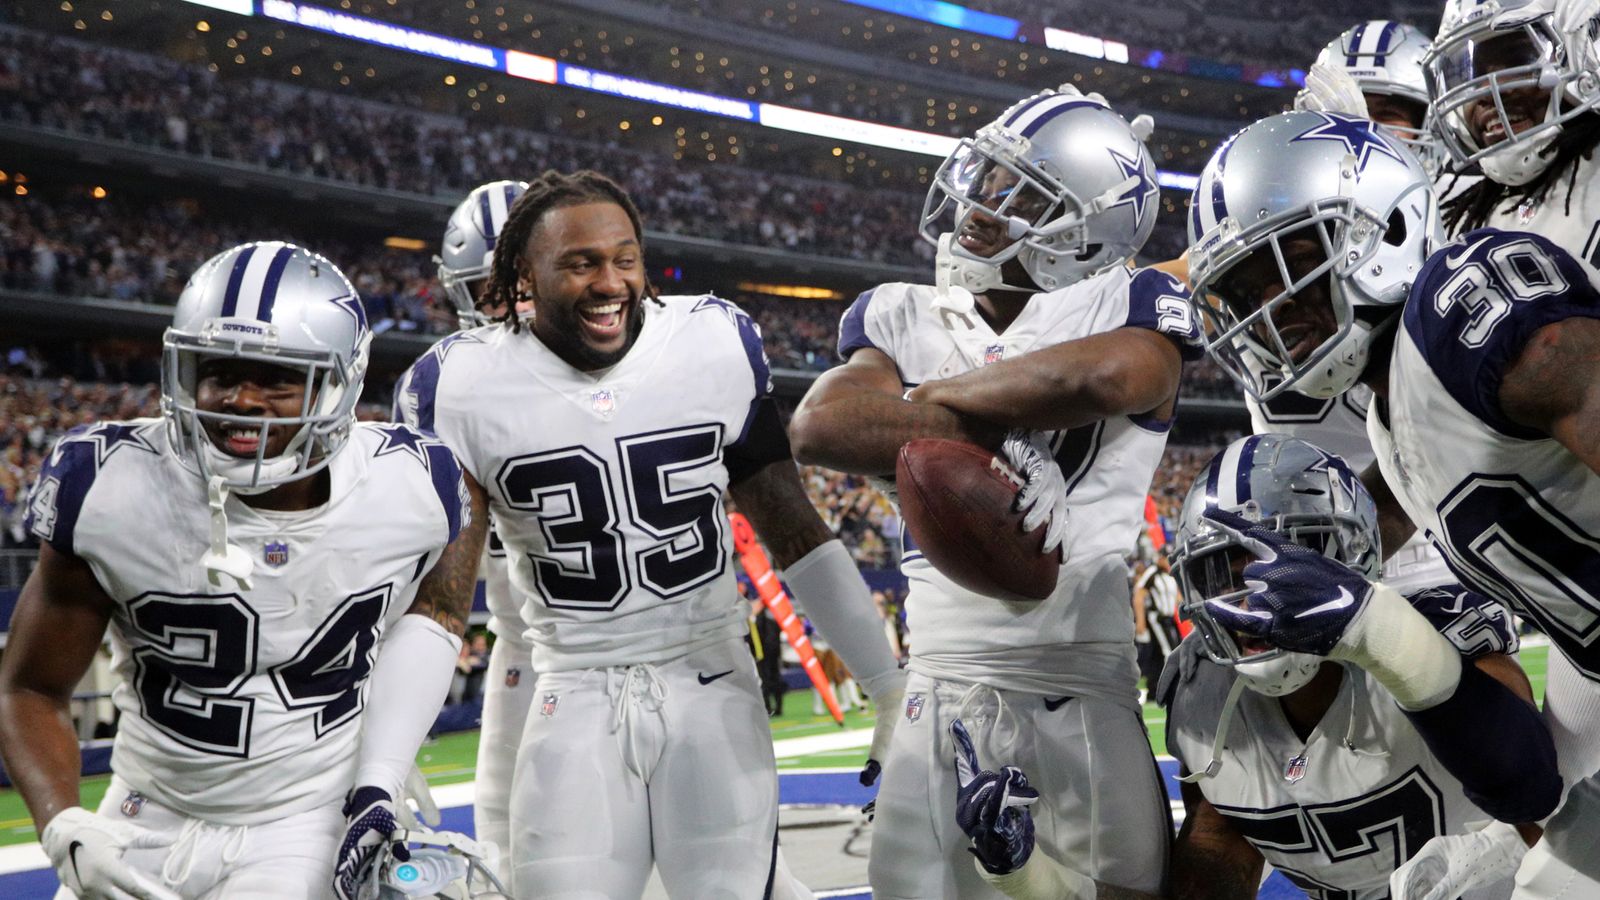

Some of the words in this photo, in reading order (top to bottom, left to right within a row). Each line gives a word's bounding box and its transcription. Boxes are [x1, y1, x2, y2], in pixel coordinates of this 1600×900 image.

[222, 323, 263, 335] COWBOYS
[1434, 239, 1570, 349] 30
[267, 552, 286, 564] NFL
[495, 422, 726, 612] 35
[1440, 600, 1520, 656] 57
[127, 582, 393, 759] 24
